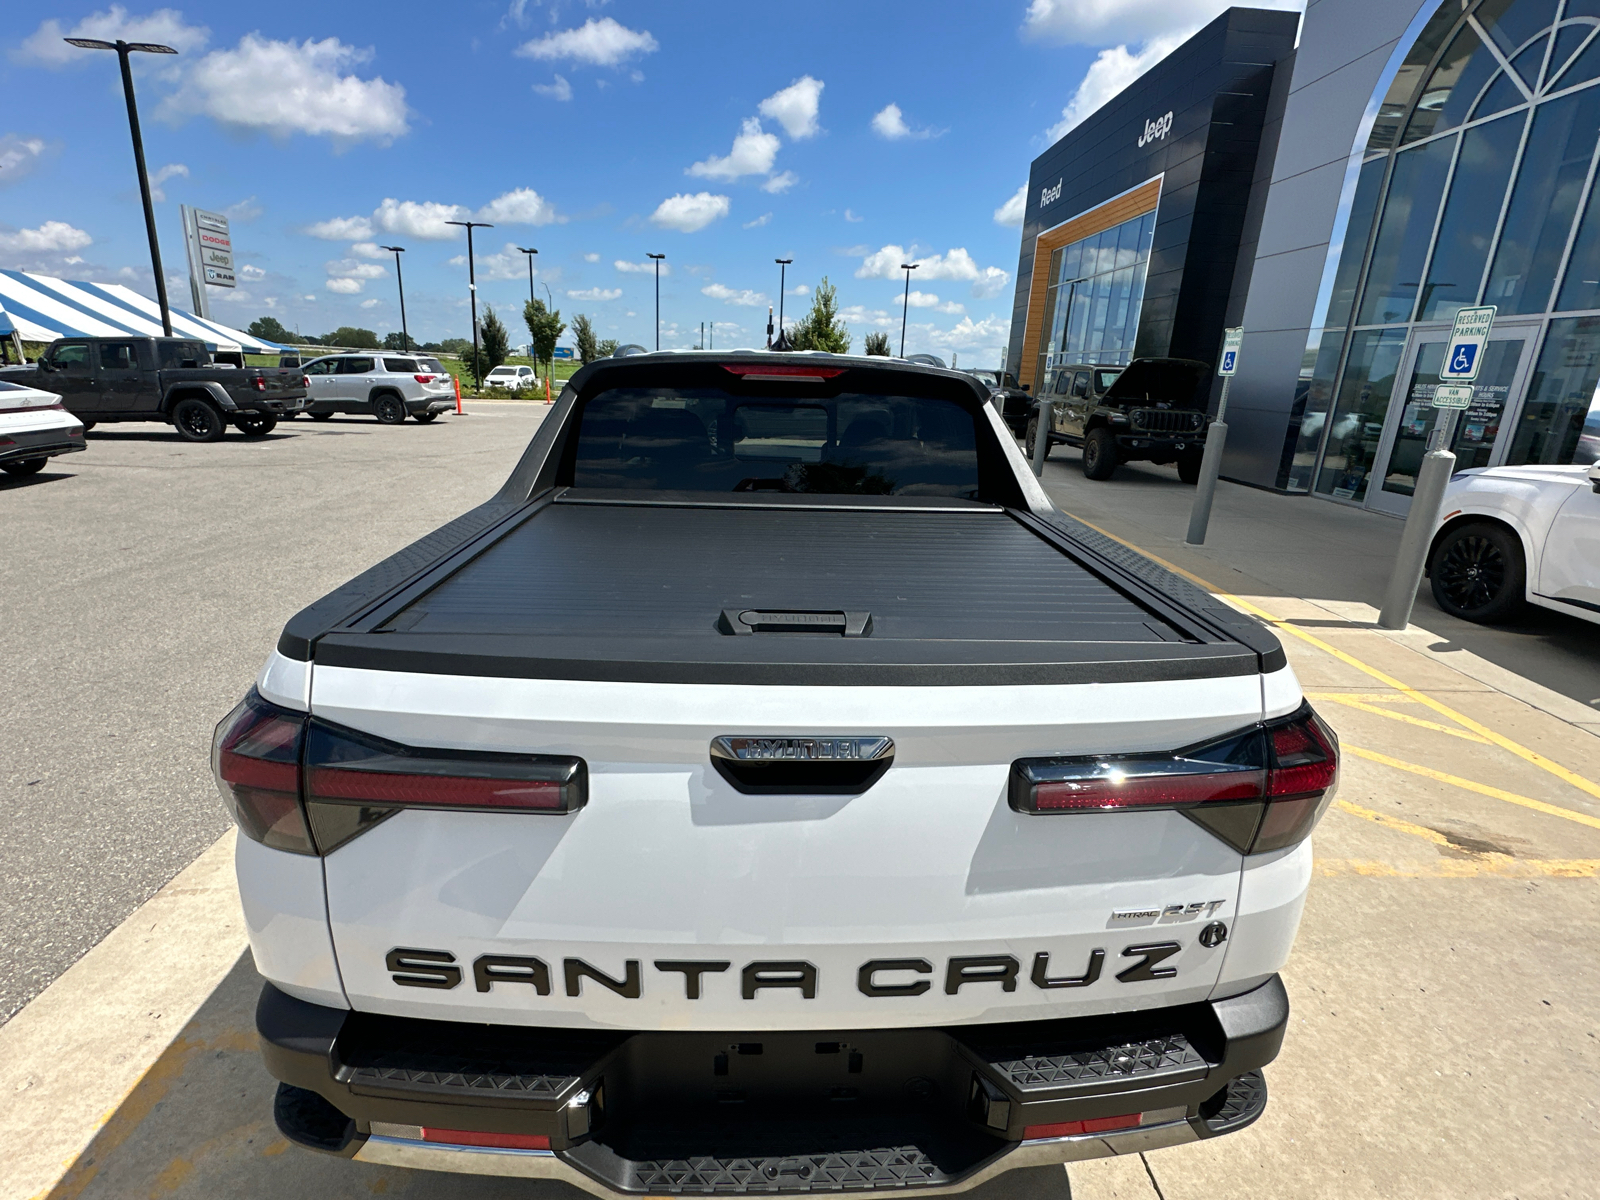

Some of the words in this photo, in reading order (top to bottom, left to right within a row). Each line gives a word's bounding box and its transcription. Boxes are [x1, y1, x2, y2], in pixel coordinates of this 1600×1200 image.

[1137, 110, 1174, 148] Jeep
[1039, 177, 1063, 208] Reed
[202, 235, 229, 246] DODGE
[210, 252, 229, 265] Jeep
[216, 273, 235, 281] RAM
[1458, 313, 1490, 325] RESERVED
[1454, 327, 1486, 336] PARKING
[1435, 396, 1468, 405] ACCESSIBLE
[746, 739, 861, 759] HYUNDAI
[1117, 910, 1158, 919] HTRAC
[385, 945, 818, 999] SANTA
[858, 940, 1181, 997] CRUZ
